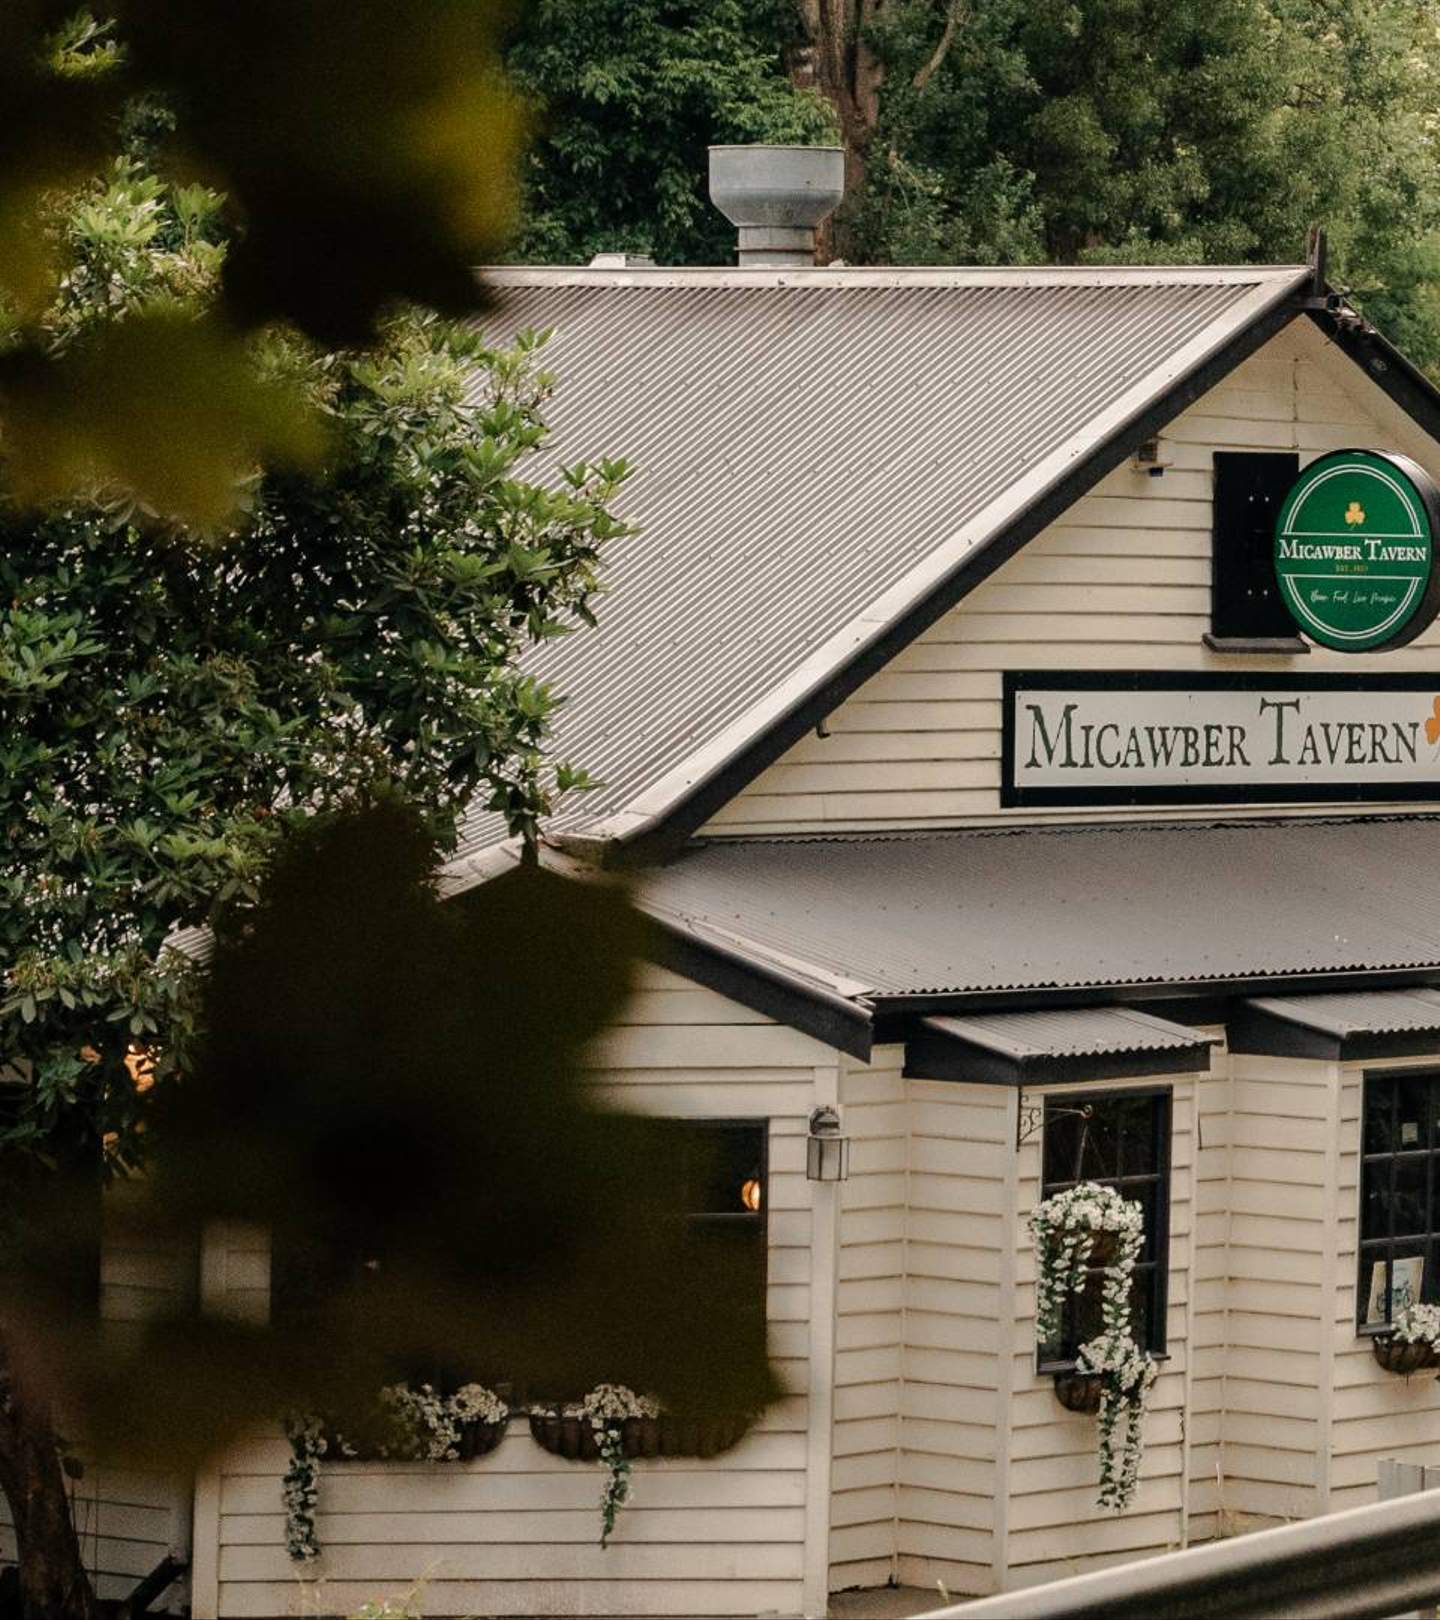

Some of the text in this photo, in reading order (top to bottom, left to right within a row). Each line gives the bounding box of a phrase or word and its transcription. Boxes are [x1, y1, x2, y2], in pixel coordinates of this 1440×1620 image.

[1278, 538, 1427, 561] MICAWBER TAVERN
[1024, 697, 1420, 769] MICAWBER TAVERN
